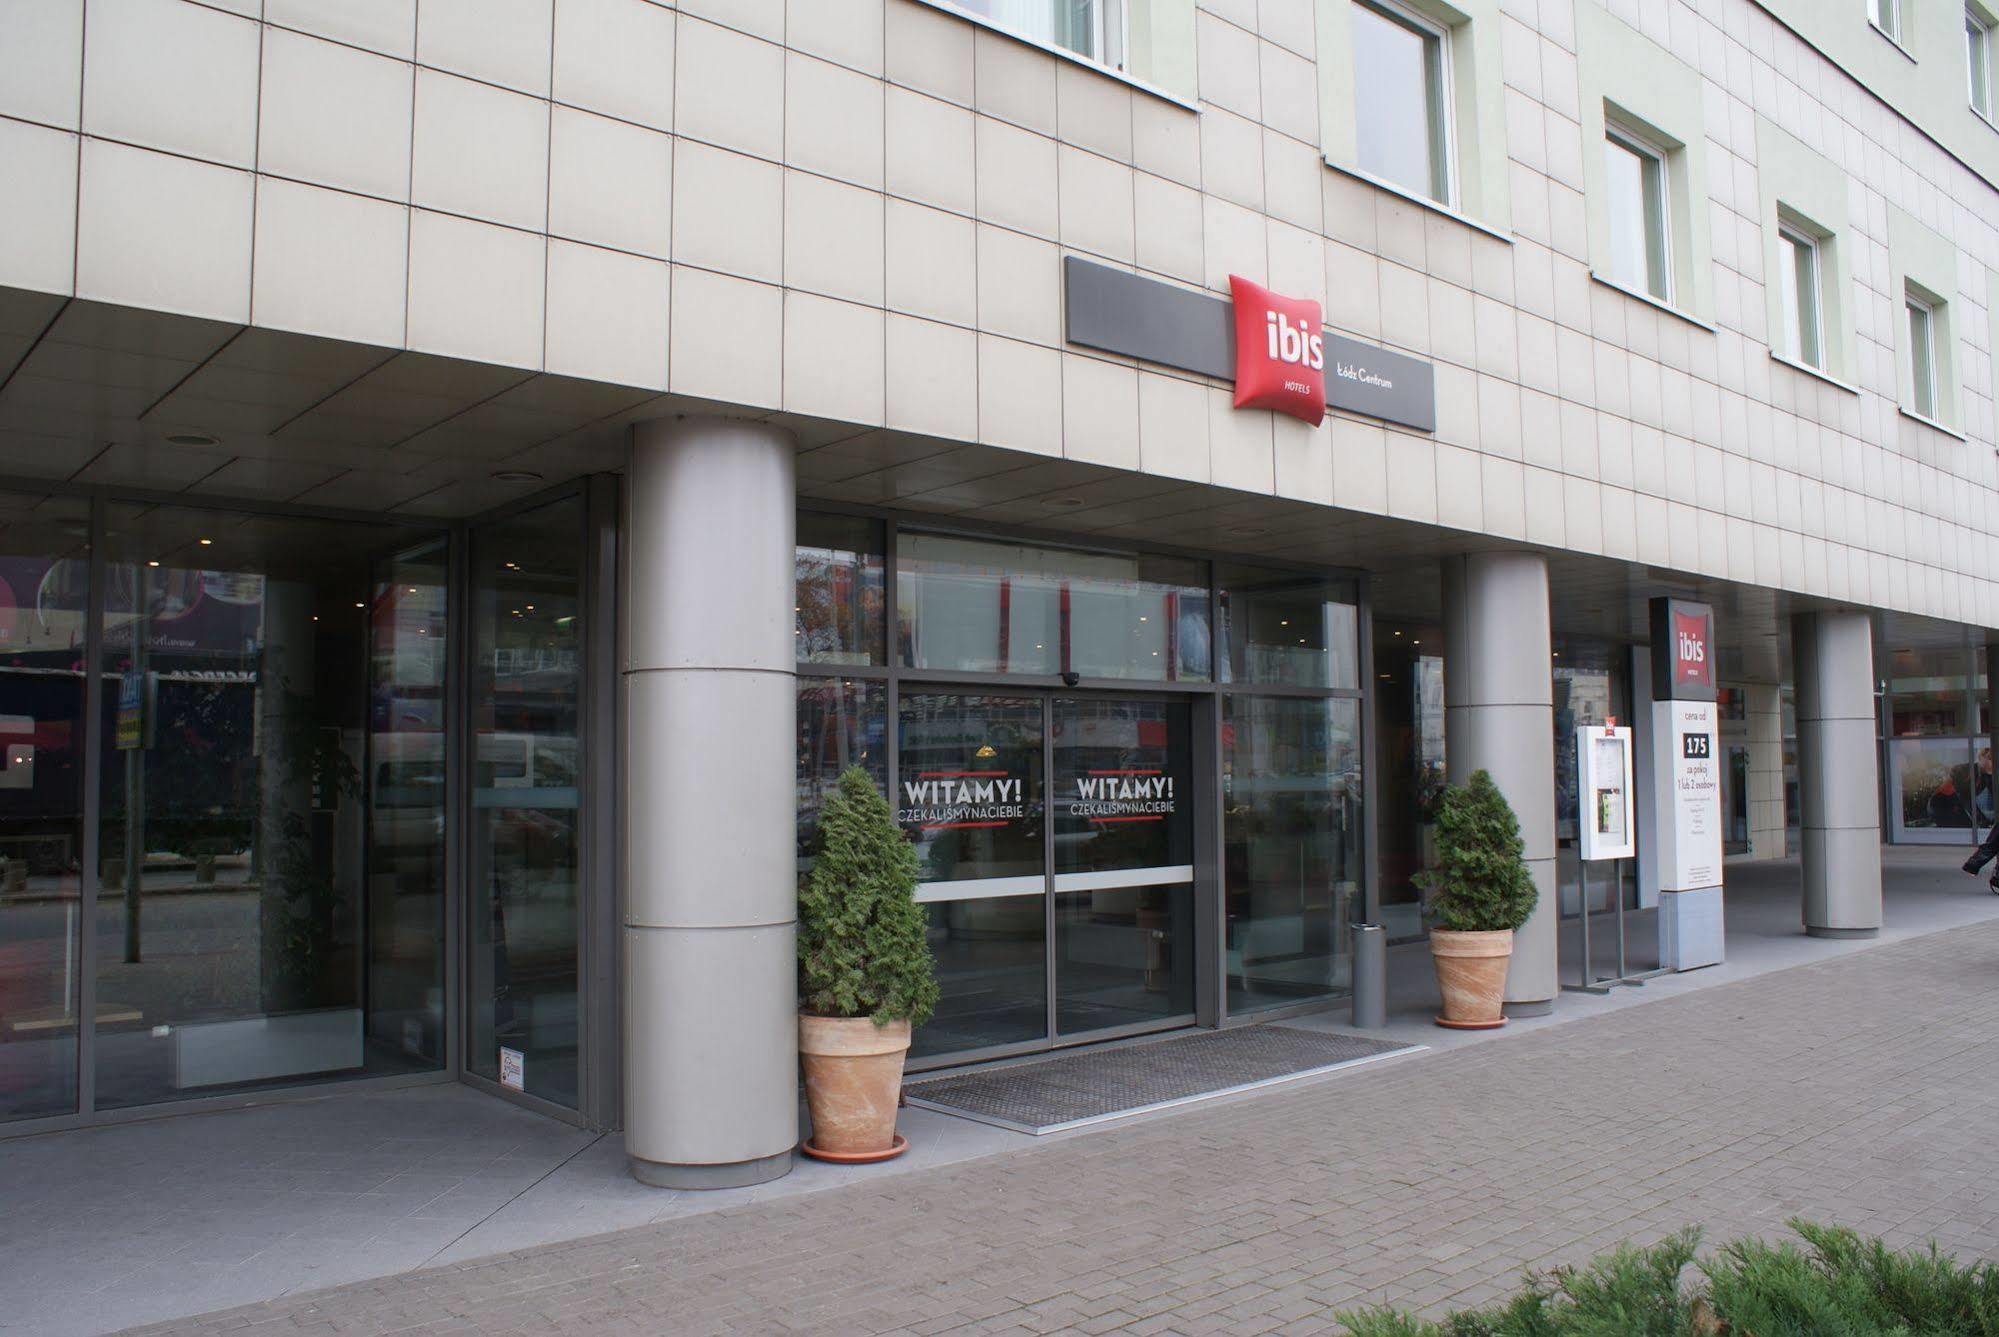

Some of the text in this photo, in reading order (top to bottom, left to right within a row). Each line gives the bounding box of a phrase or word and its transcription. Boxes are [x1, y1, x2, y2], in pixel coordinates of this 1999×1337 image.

[1267, 311, 1323, 370] ibis
[1285, 380, 1310, 395] HOTELS
[1358, 368, 1392, 389] Centrum
[1679, 632, 1704, 662] ibis
[1686, 737, 1706, 754] 175
[905, 779, 1021, 805] WITAMY!
[1077, 777, 1173, 800] WITAMY!
